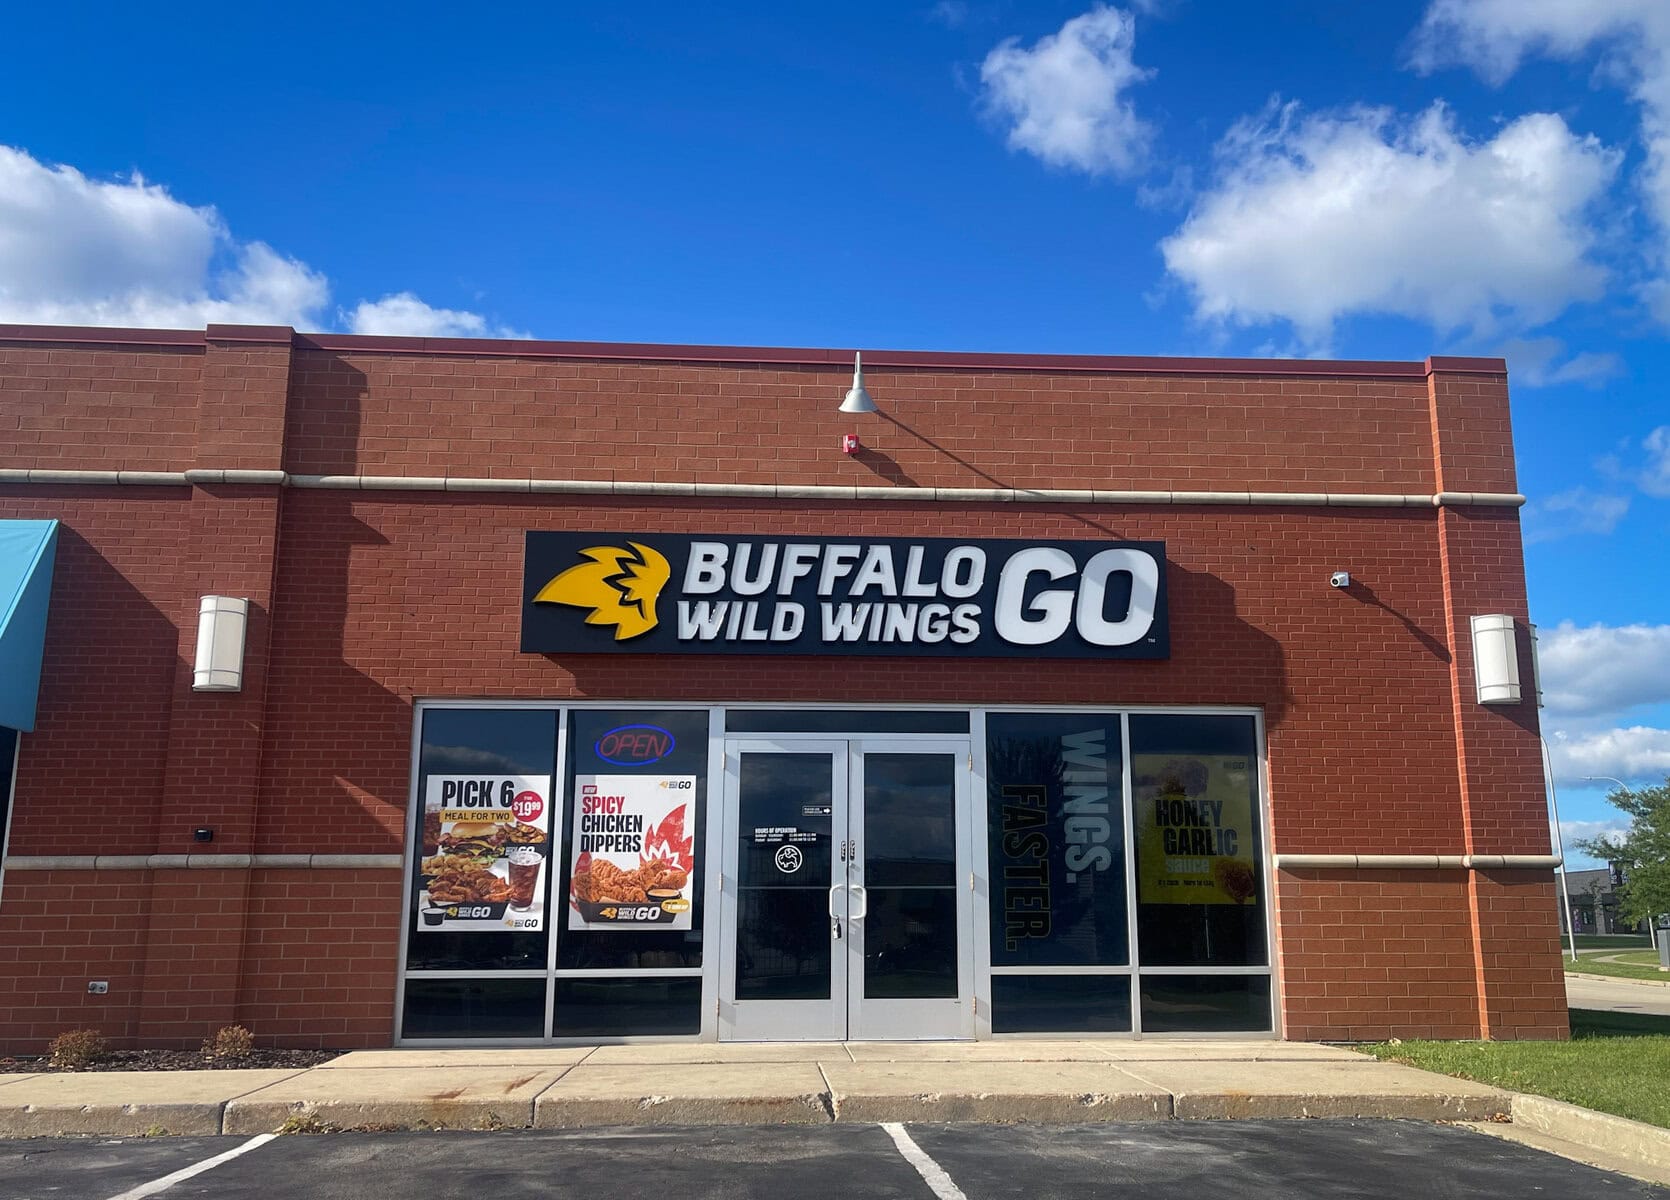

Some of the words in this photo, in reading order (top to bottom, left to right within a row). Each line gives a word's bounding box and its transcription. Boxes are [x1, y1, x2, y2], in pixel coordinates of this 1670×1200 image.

[682, 542, 987, 598] BUFFALO
[994, 546, 1159, 646] GO
[677, 600, 805, 641] WILD
[820, 602, 982, 643] WINGS
[600, 733, 668, 757] OPEN
[441, 780, 494, 807] PICK
[500, 780, 515, 807] 6
[678, 781, 692, 789] GO
[444, 812, 469, 820] MEAL
[471, 812, 489, 820] FOR
[491, 812, 510, 820] TWO
[582, 796, 625, 814] SPICY
[1061, 728, 1112, 883] WINGS.
[1155, 800, 1223, 827] HONEY
[581, 814, 643, 833] CHICKEN
[580, 834, 642, 852] DIPPERS
[1163, 828, 1238, 856] GARLIC
[1001, 784, 1051, 952] FASTER.
[471, 906, 491, 918] GO
[524, 919, 538, 927] GO
[635, 906, 661, 920] GO
